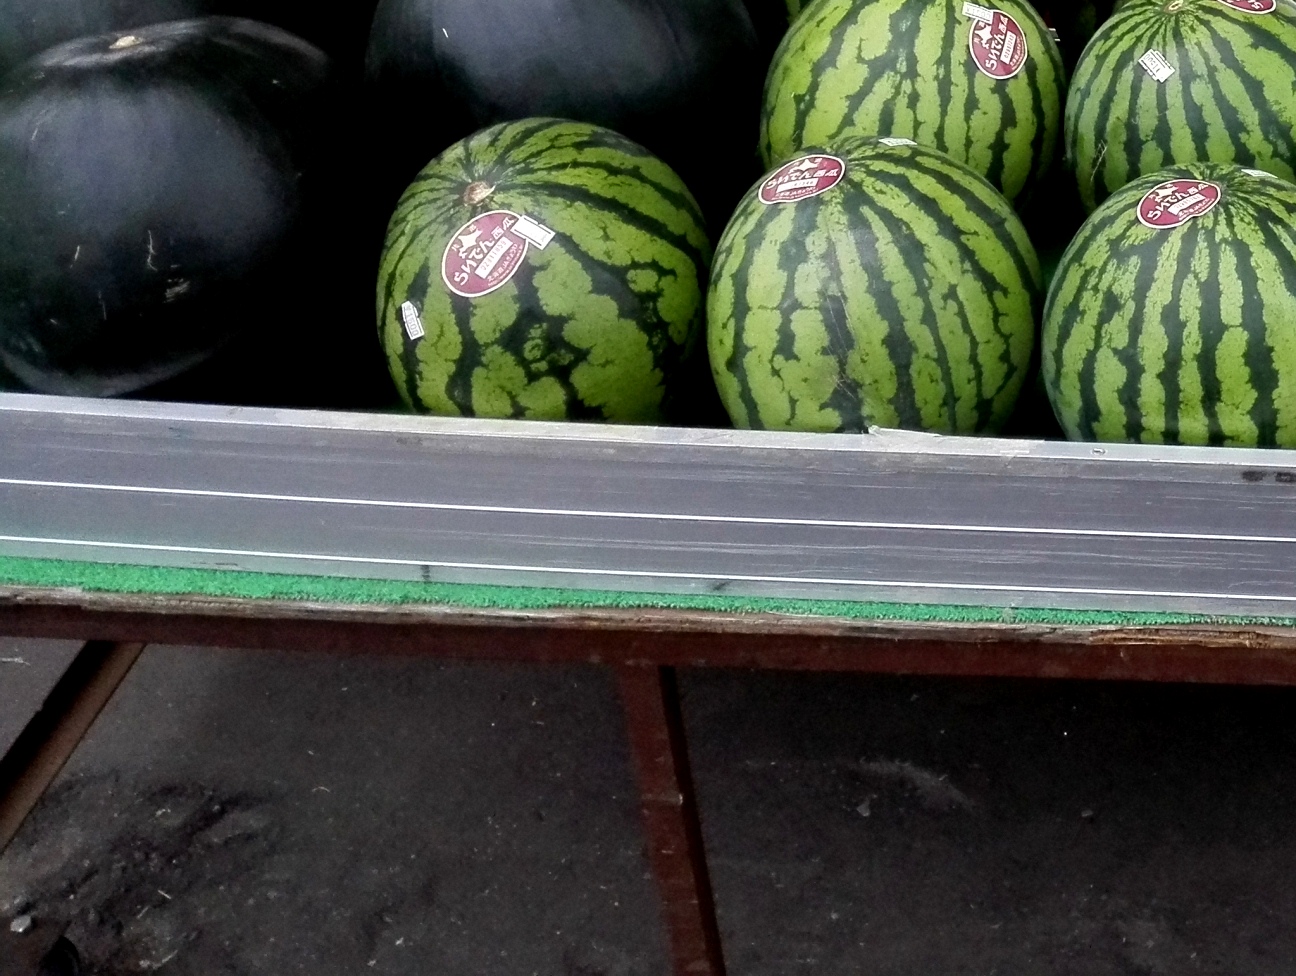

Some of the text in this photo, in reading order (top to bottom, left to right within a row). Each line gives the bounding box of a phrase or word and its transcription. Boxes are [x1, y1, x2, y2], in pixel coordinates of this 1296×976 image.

[984, 15, 1009, 71] らいでん西瓜
[766, 168, 839, 190] らいでん西瓜
[1147, 184, 1209, 221] らいでん西瓜
[454, 216, 515, 286] らいでん西瓜
